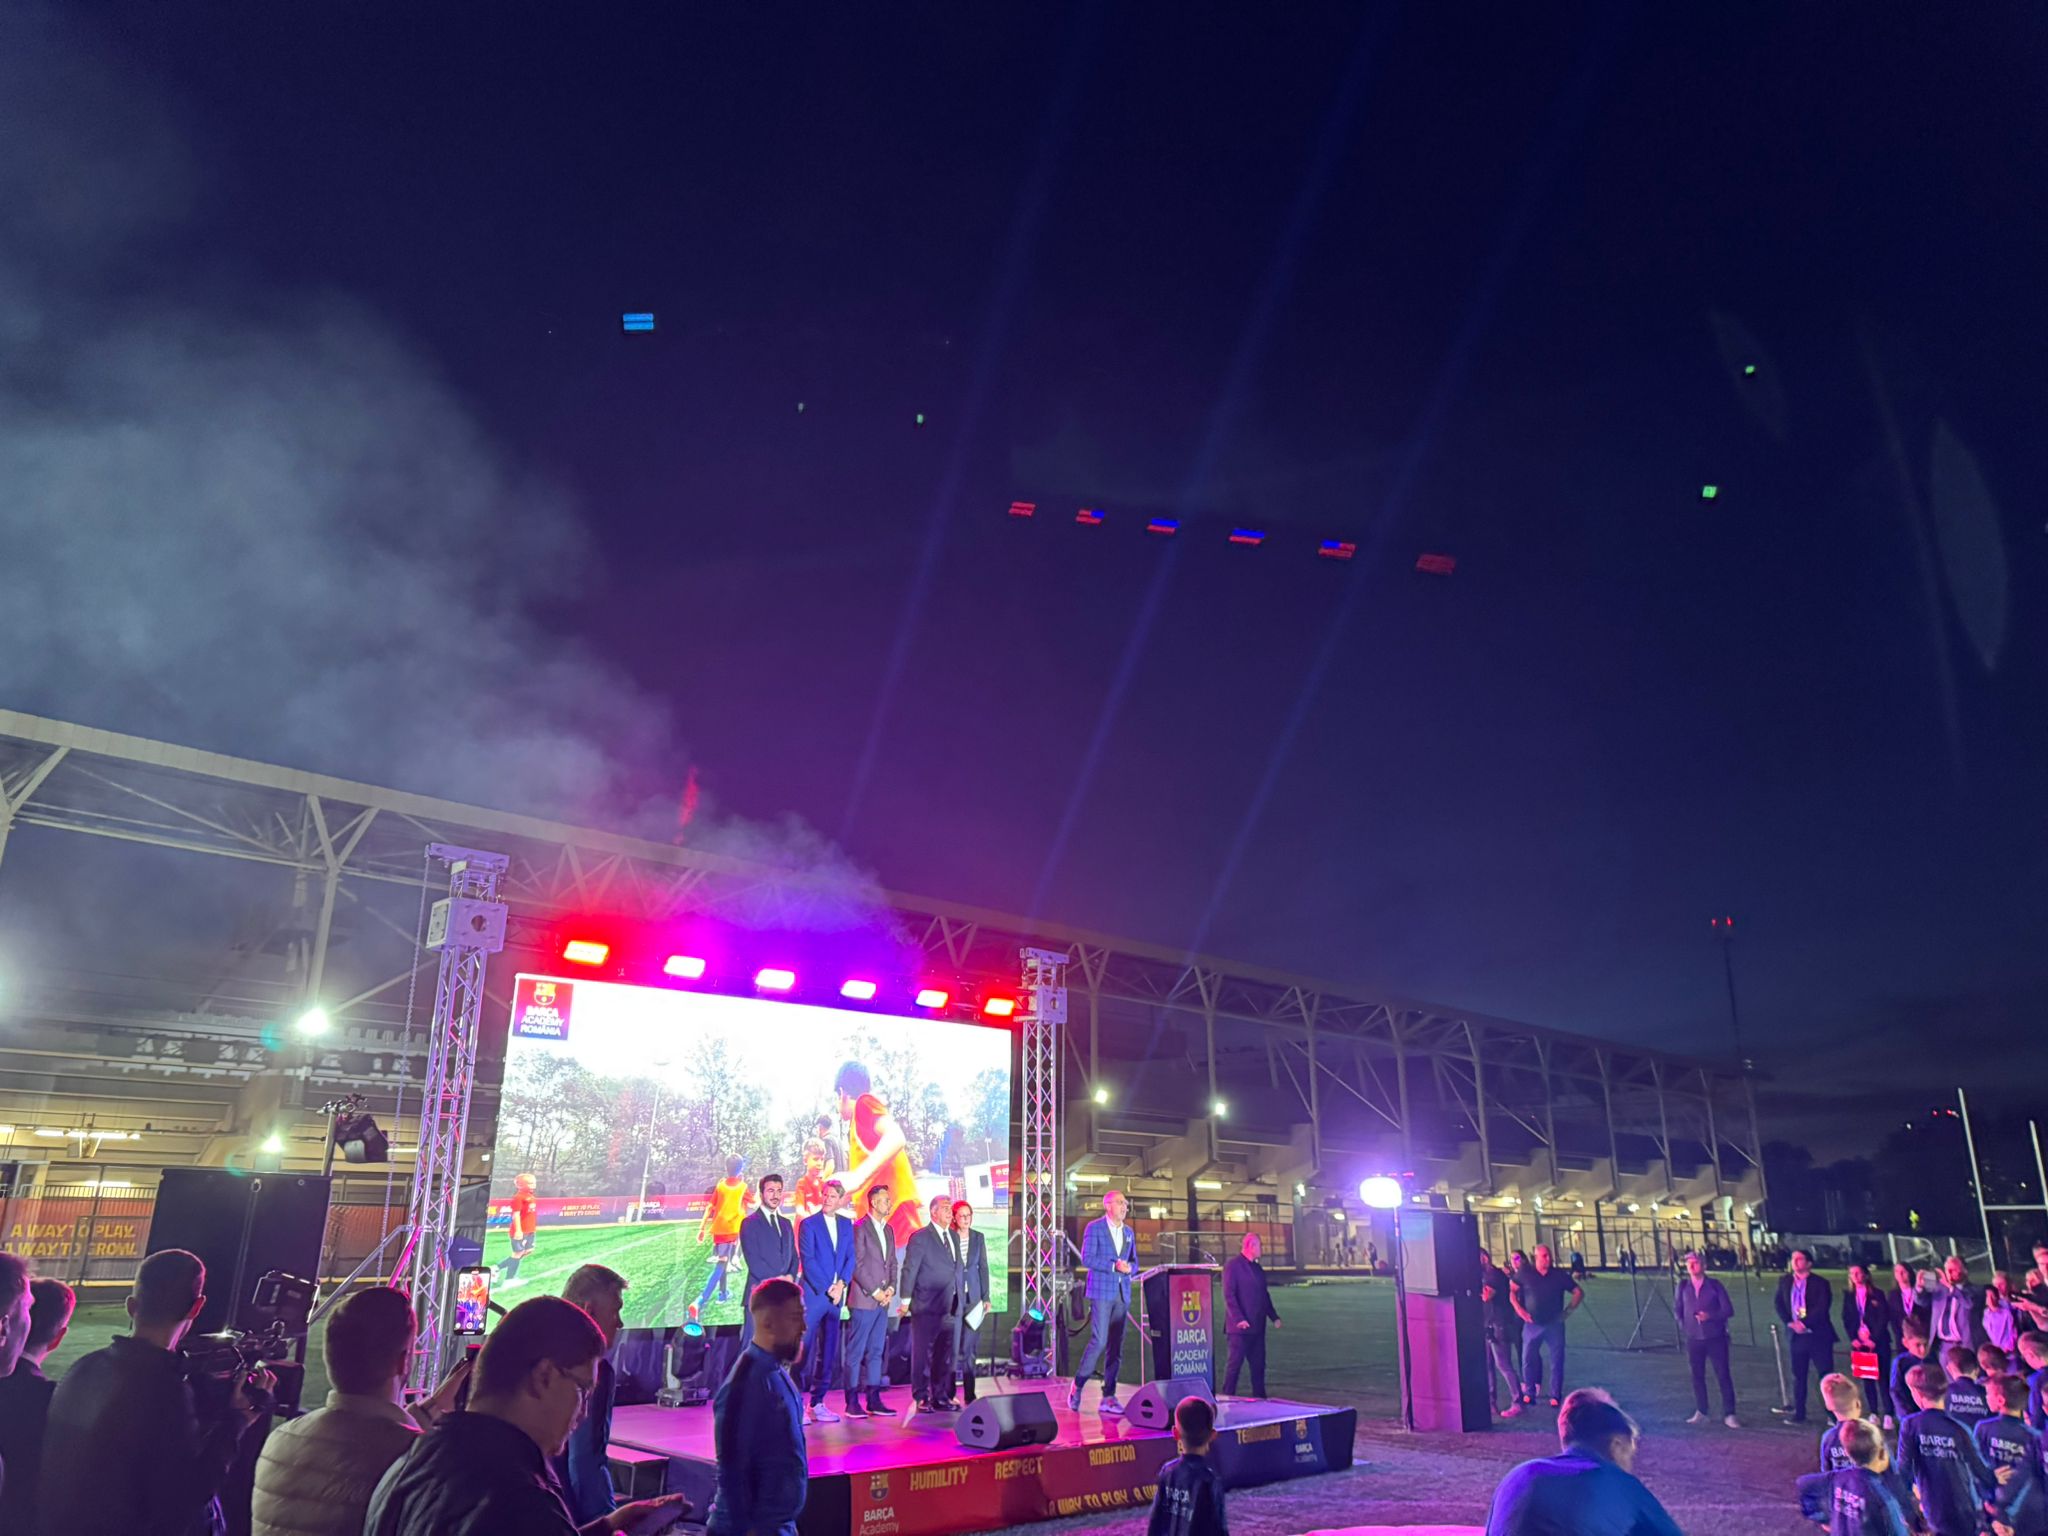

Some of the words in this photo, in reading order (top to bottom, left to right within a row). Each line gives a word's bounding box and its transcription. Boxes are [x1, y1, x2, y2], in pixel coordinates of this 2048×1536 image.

[11, 1223, 23, 1238] A
[27, 1223, 68, 1238] WAY
[18, 1242, 59, 1256] WAY
[1177, 1328, 1207, 1345] BARÇA
[1173, 1349, 1208, 1361] ACADEMY
[1174, 1361, 1208, 1375] ROMÂNIA
[1950, 1393, 1984, 1406] BARÇA
[1919, 1434, 1956, 1449] BARÇA
[1089, 1444, 1137, 1466] AMBITION
[994, 1456, 1043, 1480] RESPECT
[909, 1465, 968, 1491] HUMILITY
[1057, 1496, 1082, 1516] WAY
[1084, 1493, 1102, 1509] TO
[1133, 1487, 1145, 1502] A
[863, 1507, 895, 1522] BARÇA
[859, 1521, 899, 1536] Academy
